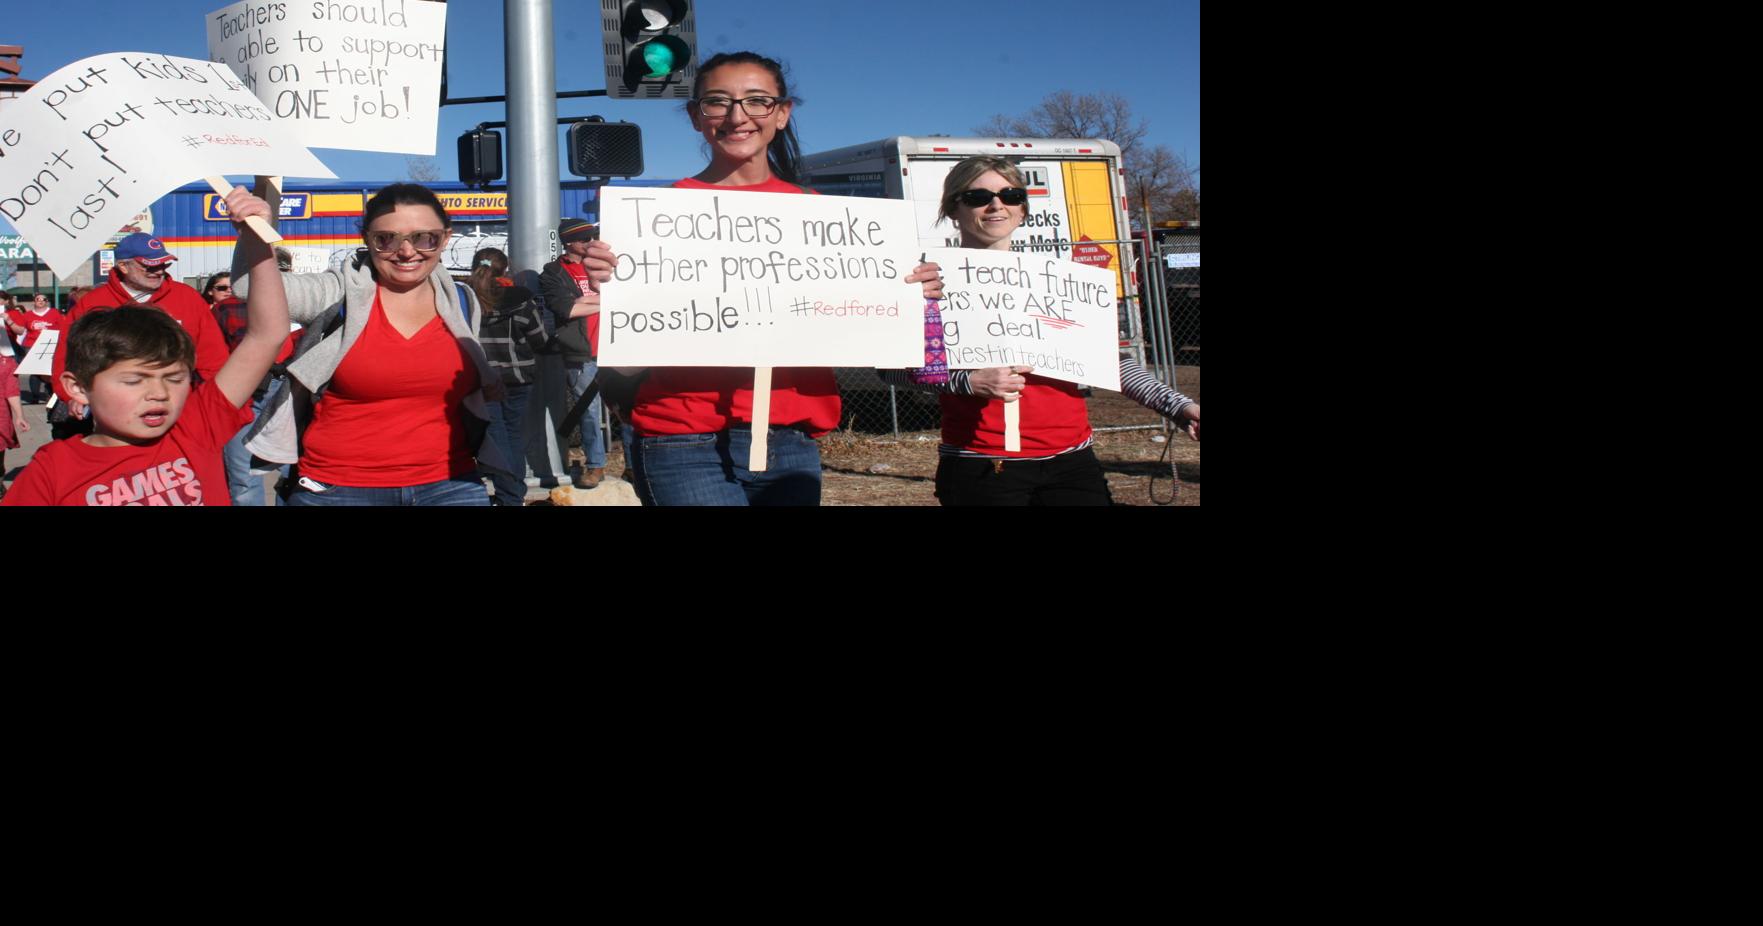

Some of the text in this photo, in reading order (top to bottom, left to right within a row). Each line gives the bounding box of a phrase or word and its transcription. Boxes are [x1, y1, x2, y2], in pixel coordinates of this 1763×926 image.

[216, 0, 408, 42] Teachers should
[237, 29, 444, 67] able to support
[42, 66, 107, 120] put
[268, 63, 300, 83] on
[316, 60, 389, 87] their
[275, 86, 412, 124] ONE job!
[0, 94, 272, 222] Don't put teachers
[47, 154, 137, 239] last!
[621, 196, 885, 247] Teachers make
[721, 249, 898, 292] professions
[958, 257, 1111, 308] teach future
[610, 286, 775, 344] possible!!!
[979, 293, 1016, 310] we
[1023, 293, 1076, 323] ARE
[987, 314, 1046, 340] deal.
[85, 457, 195, 506] GAMES
